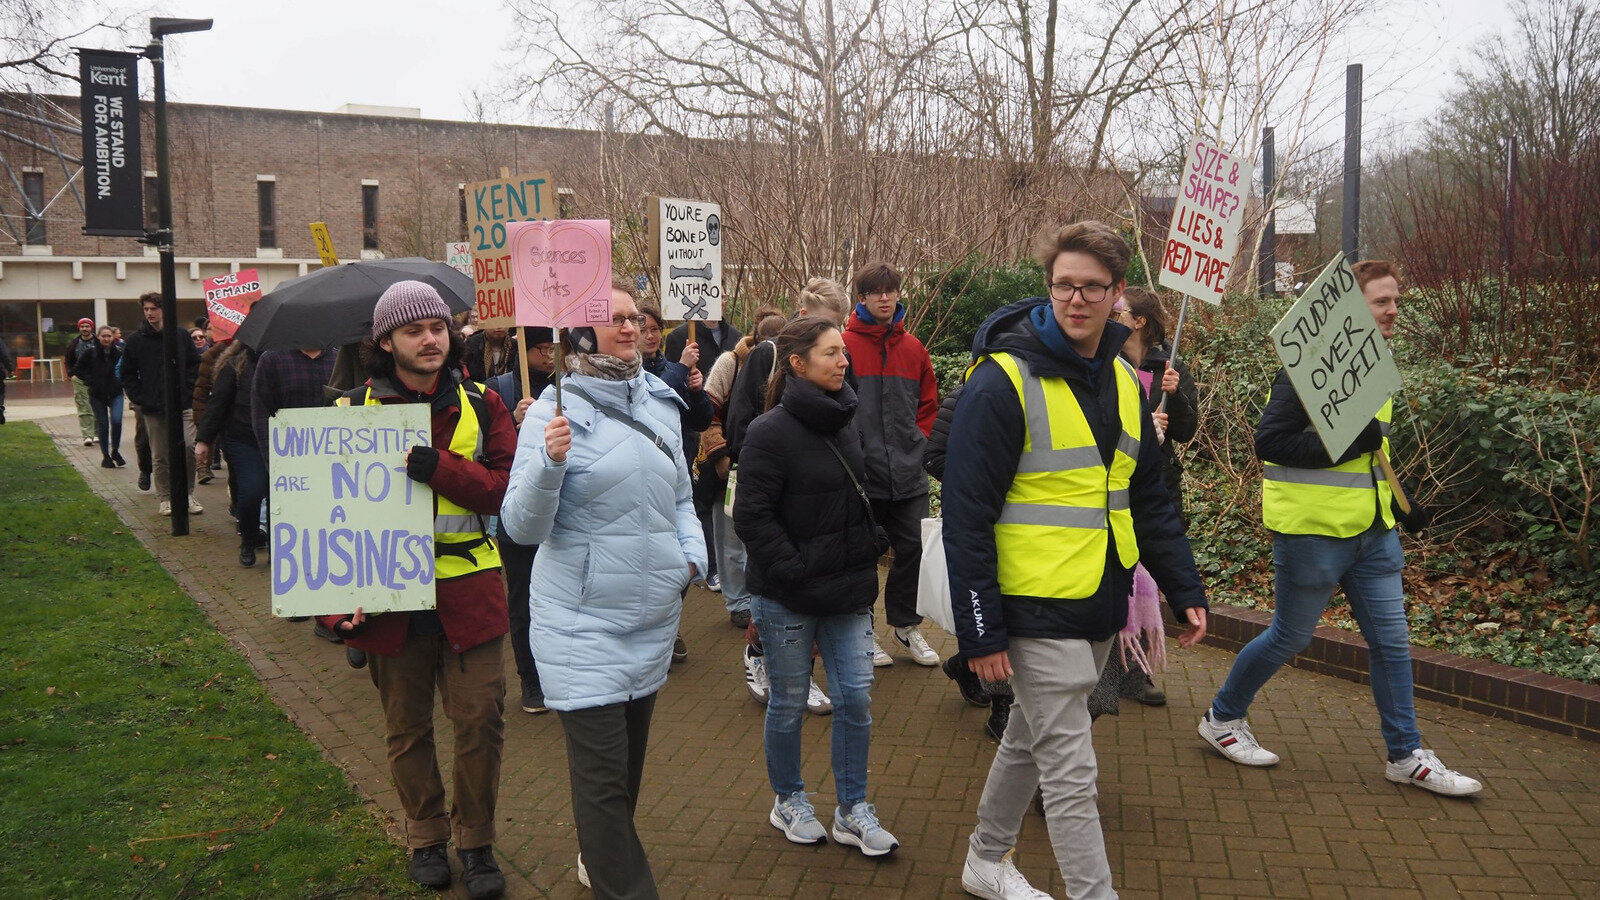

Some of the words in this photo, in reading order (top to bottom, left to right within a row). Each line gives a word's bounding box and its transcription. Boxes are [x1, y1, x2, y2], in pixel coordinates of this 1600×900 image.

[90, 70, 127, 86] Kent
[94, 95, 107, 125] FOR
[110, 96, 123, 118] WE
[95, 126, 111, 199] AMBITION.
[110, 121, 125, 168] STAND
[1192, 142, 1229, 183] SIZE
[1228, 162, 1240, 187] &
[474, 178, 547, 222] KENT
[1184, 174, 1240, 223] SHAPE?
[1177, 206, 1213, 245] LIES
[1213, 226, 1224, 249] &
[453, 243, 471, 255] SAV
[668, 248, 704, 260] WITHOUT
[1163, 239, 1192, 276] RED
[1195, 251, 1230, 293] TAPE
[213, 274, 237, 285] WE
[475, 255, 511, 284] DEAT
[207, 281, 260, 301] DEMAND
[542, 278, 571, 300] Arts
[668, 282, 720, 298] ANTHRO
[209, 300, 246, 325] TRANSPAR
[1281, 255, 1354, 368] STUDENTS
[1311, 315, 1364, 390] OVER
[1320, 328, 1381, 429] PROFIT
[273, 426, 429, 457] UNIVERSITIES
[274, 475, 310, 492] ARE
[331, 461, 412, 505] NOT
[330, 505, 346, 524] A
[273, 522, 434, 595] BUSINESS
[969, 590, 985, 638] AKUMA
